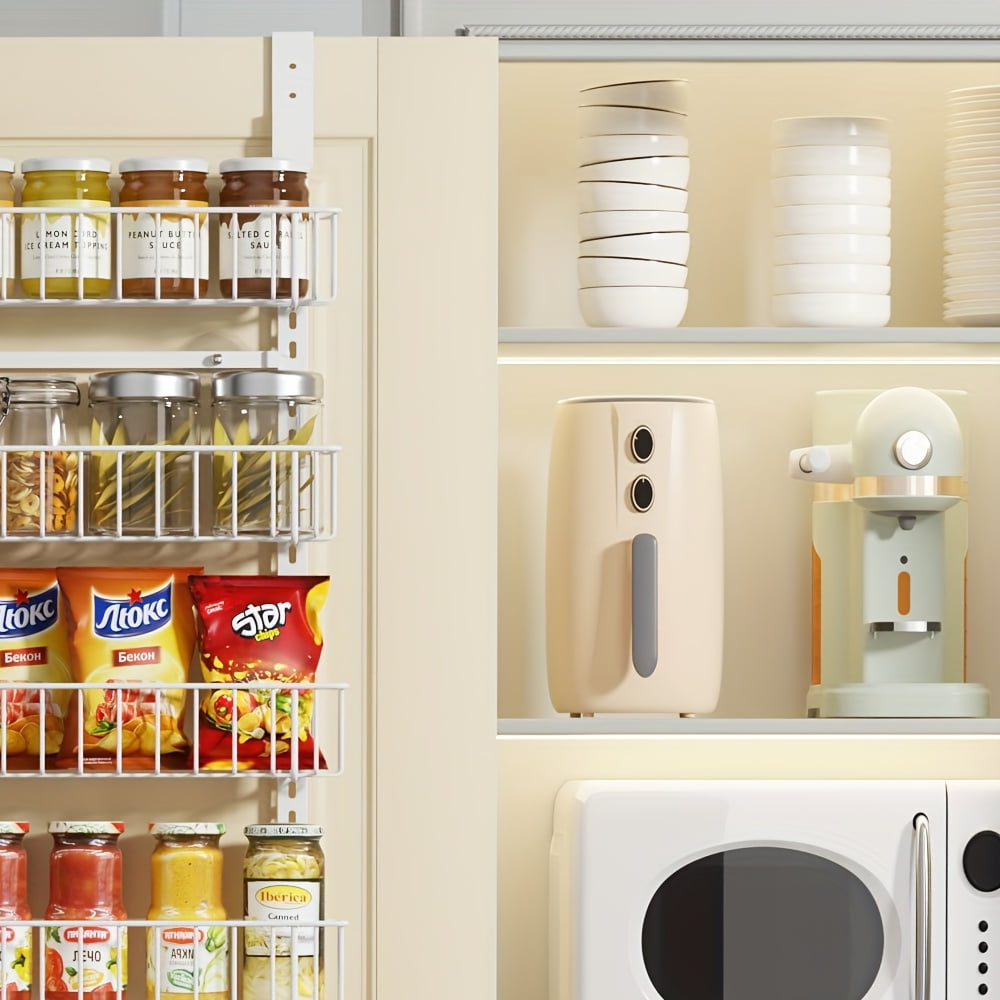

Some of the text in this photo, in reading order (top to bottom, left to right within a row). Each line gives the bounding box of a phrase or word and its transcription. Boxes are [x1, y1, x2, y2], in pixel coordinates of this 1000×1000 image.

[35, 230, 68, 239] LMON
[227, 230, 260, 239] SLTED
[149, 241, 182, 249] SUCE
[95, 597, 169, 632] Люкс
[4, 651, 42, 664] Бекон
[117, 651, 156, 664] Бекон
[260, 890, 307, 904] Iberica
[267, 912, 300, 921] Canned
